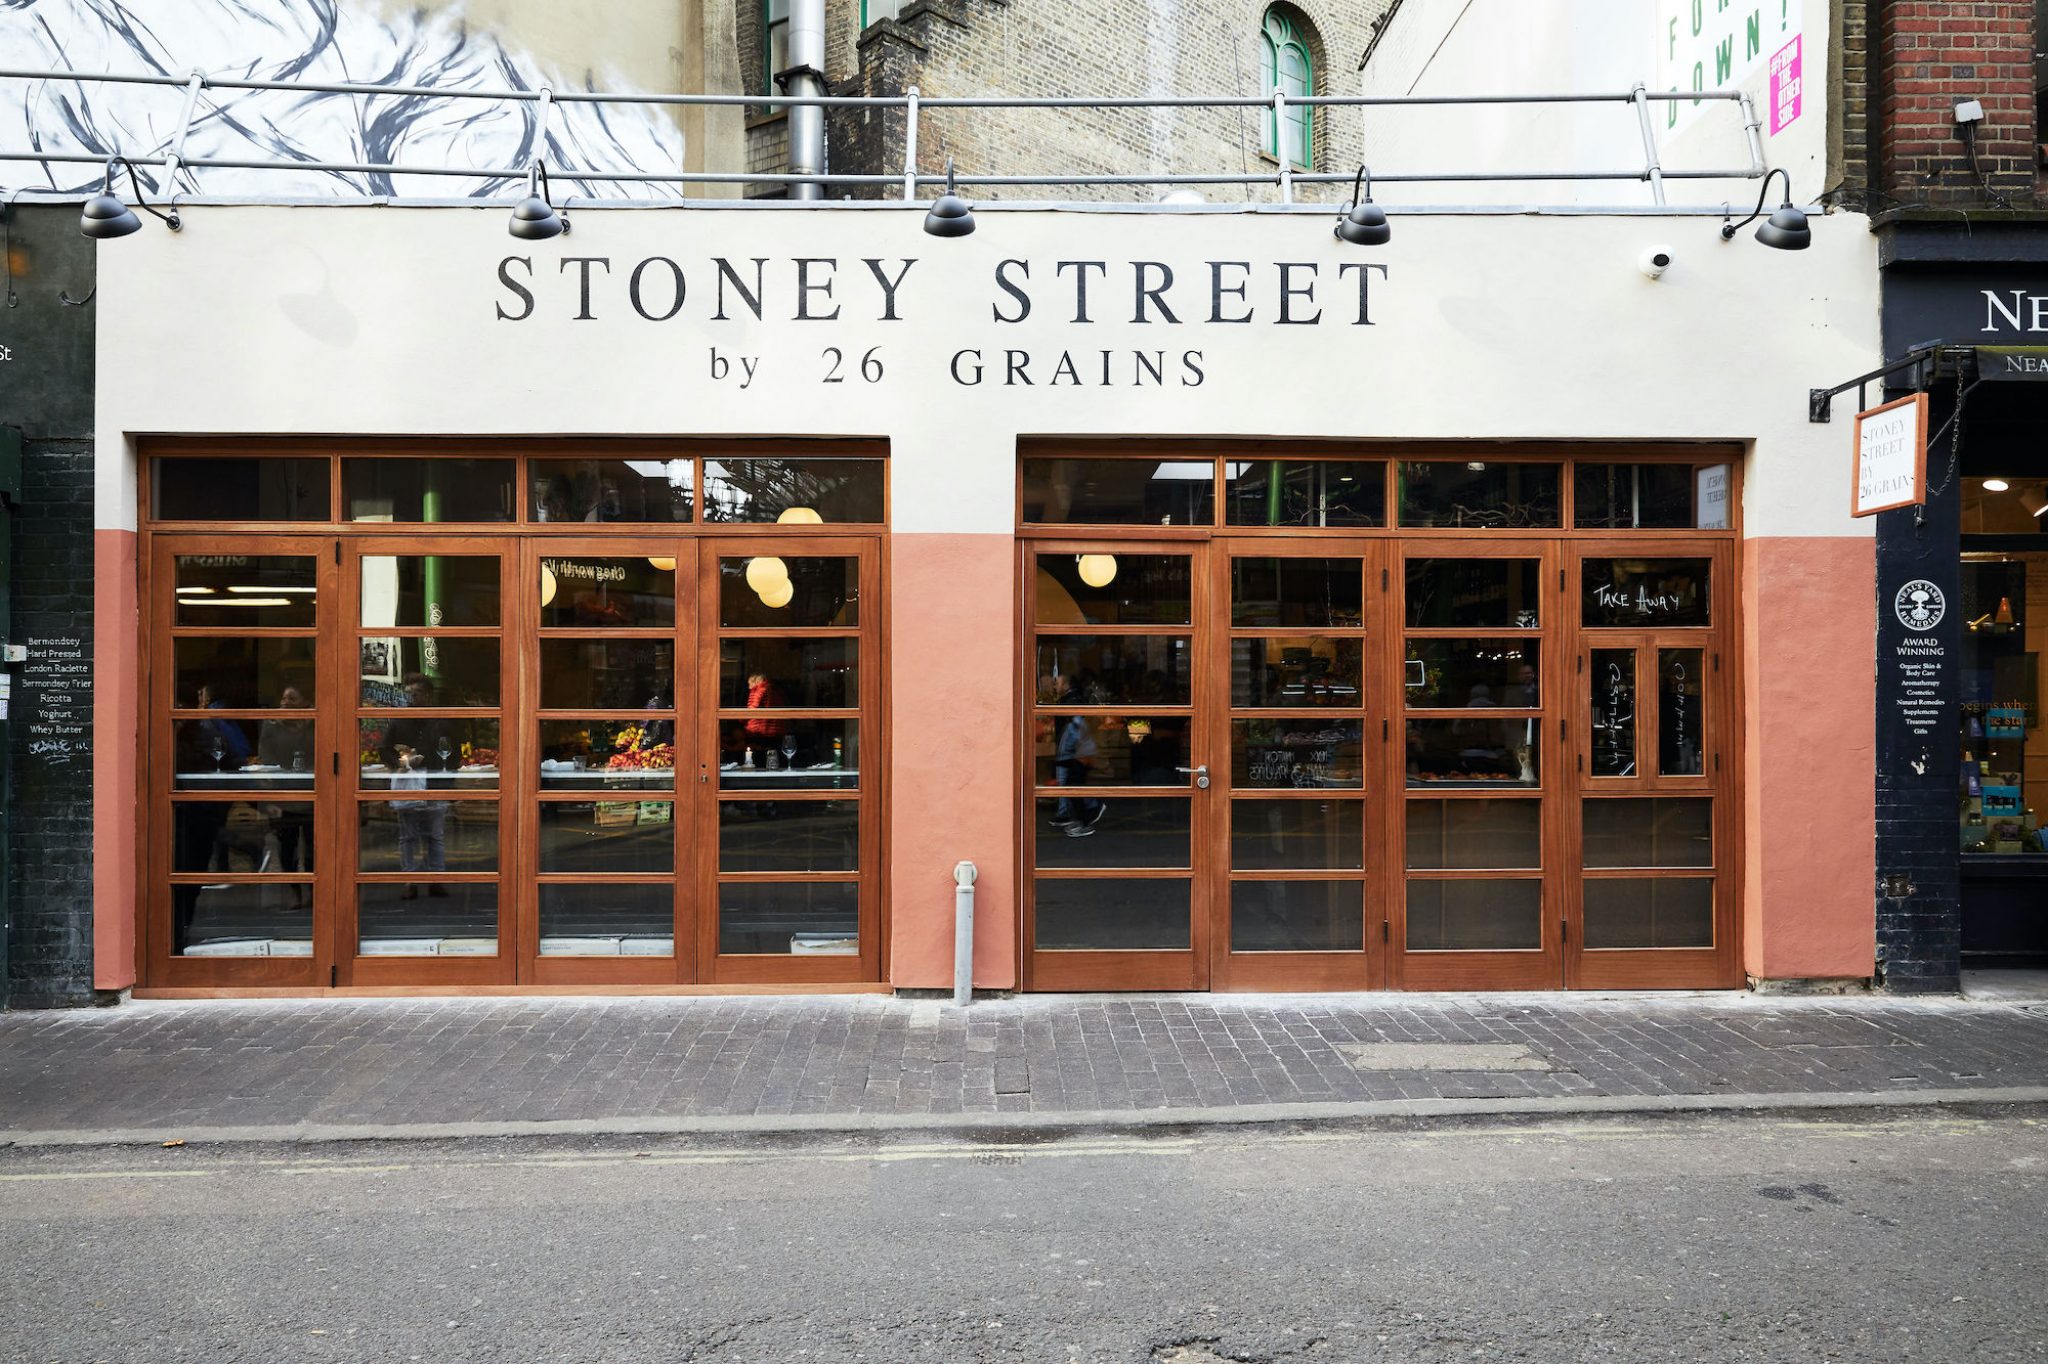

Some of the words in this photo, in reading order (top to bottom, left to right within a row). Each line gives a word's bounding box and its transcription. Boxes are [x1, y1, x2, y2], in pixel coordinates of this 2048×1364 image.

[1771, 38, 1798, 78] #FROM
[1777, 63, 1792, 90] THE
[1777, 76, 1801, 109] OTHER
[1777, 100, 1795, 128] SIDE
[496, 256, 919, 321] STONEY
[992, 259, 1388, 326] STREET
[710, 347, 760, 390] by
[822, 346, 885, 384] 26
[950, 348, 1206, 387] GRAINS
[1862, 419, 1905, 444] STONEY
[1862, 437, 1905, 463] STREET
[1861, 465, 1873, 481] BY
[1860, 483, 1872, 499] 26
[1899, 583, 1922, 603] NEAL'S
[1923, 584, 1941, 603] YARD
[1900, 610, 1940, 627] REMEDIES
[28, 637, 81, 647] Bermondsey
[1902, 637, 1938, 646] AWARD
[26, 649, 46, 658] Hard
[48, 649, 81, 658] Pressed
[1896, 646, 1944, 656] WINNING
[24, 664, 52, 673] London
[54, 664, 88, 673] Raclette
[22, 679, 70, 690] Bermondsey
[40, 694, 72, 703] Ricotta
[38, 709, 72, 719] Yoghurt
[30, 725, 54, 735] Whey
[56, 725, 83, 734] Butter
